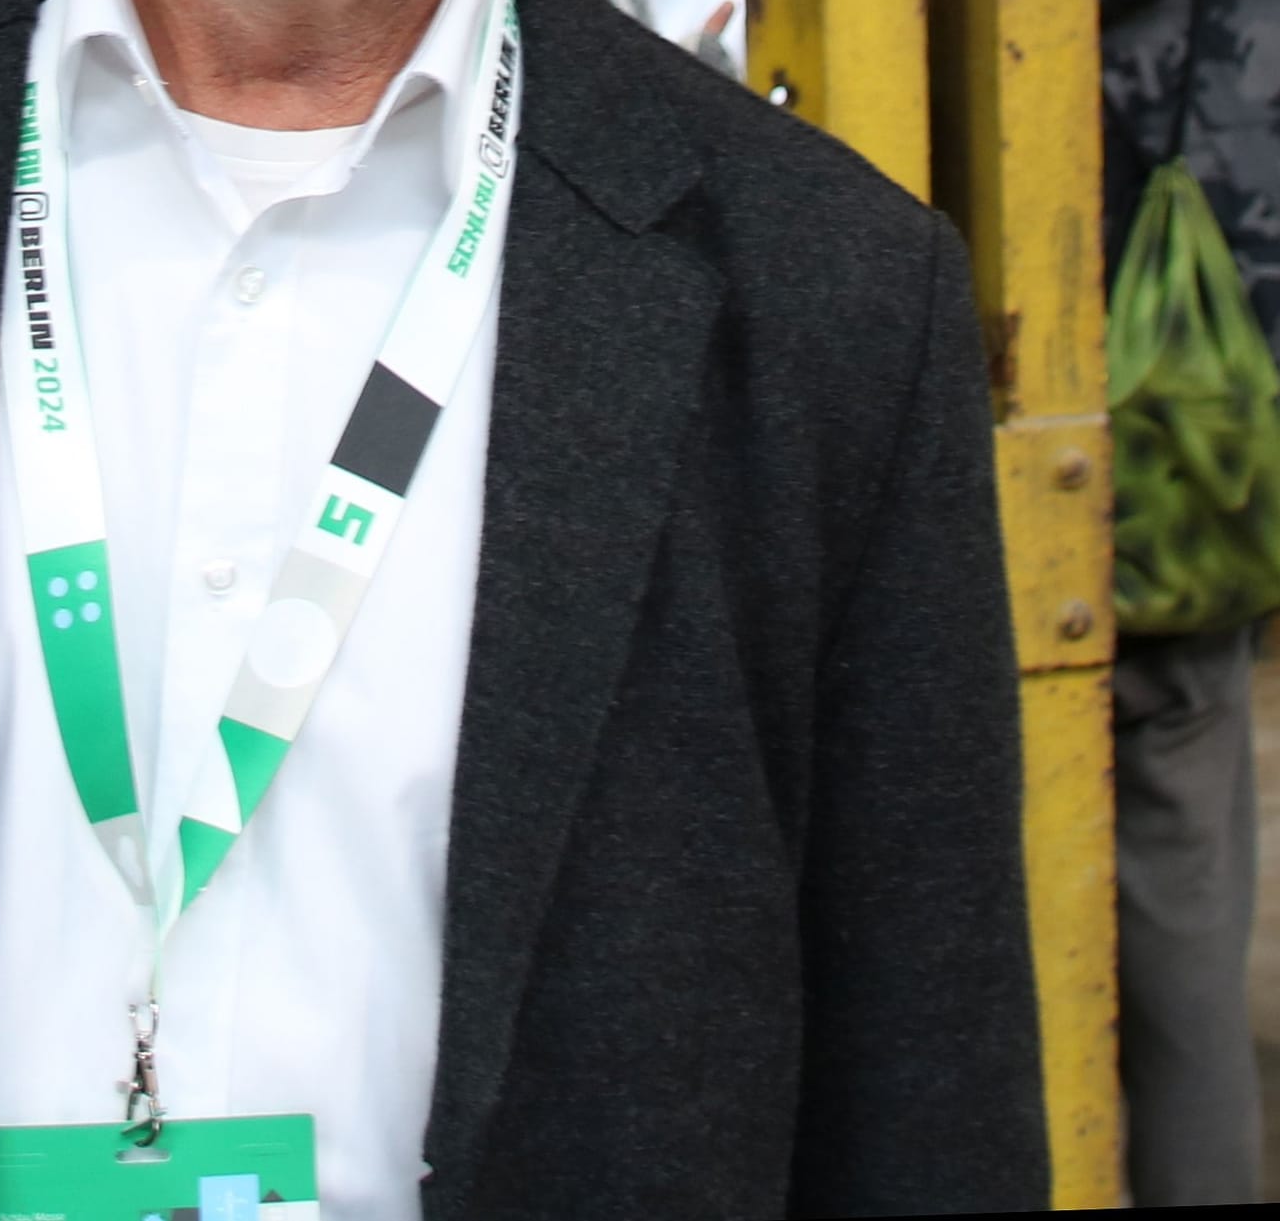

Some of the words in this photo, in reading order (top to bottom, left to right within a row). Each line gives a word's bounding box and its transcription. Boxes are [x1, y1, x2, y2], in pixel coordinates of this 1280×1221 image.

[488, 34, 516, 143] BERLIN
[21, 227, 54, 349] BERLIN
[33, 358, 66, 432] 2024
